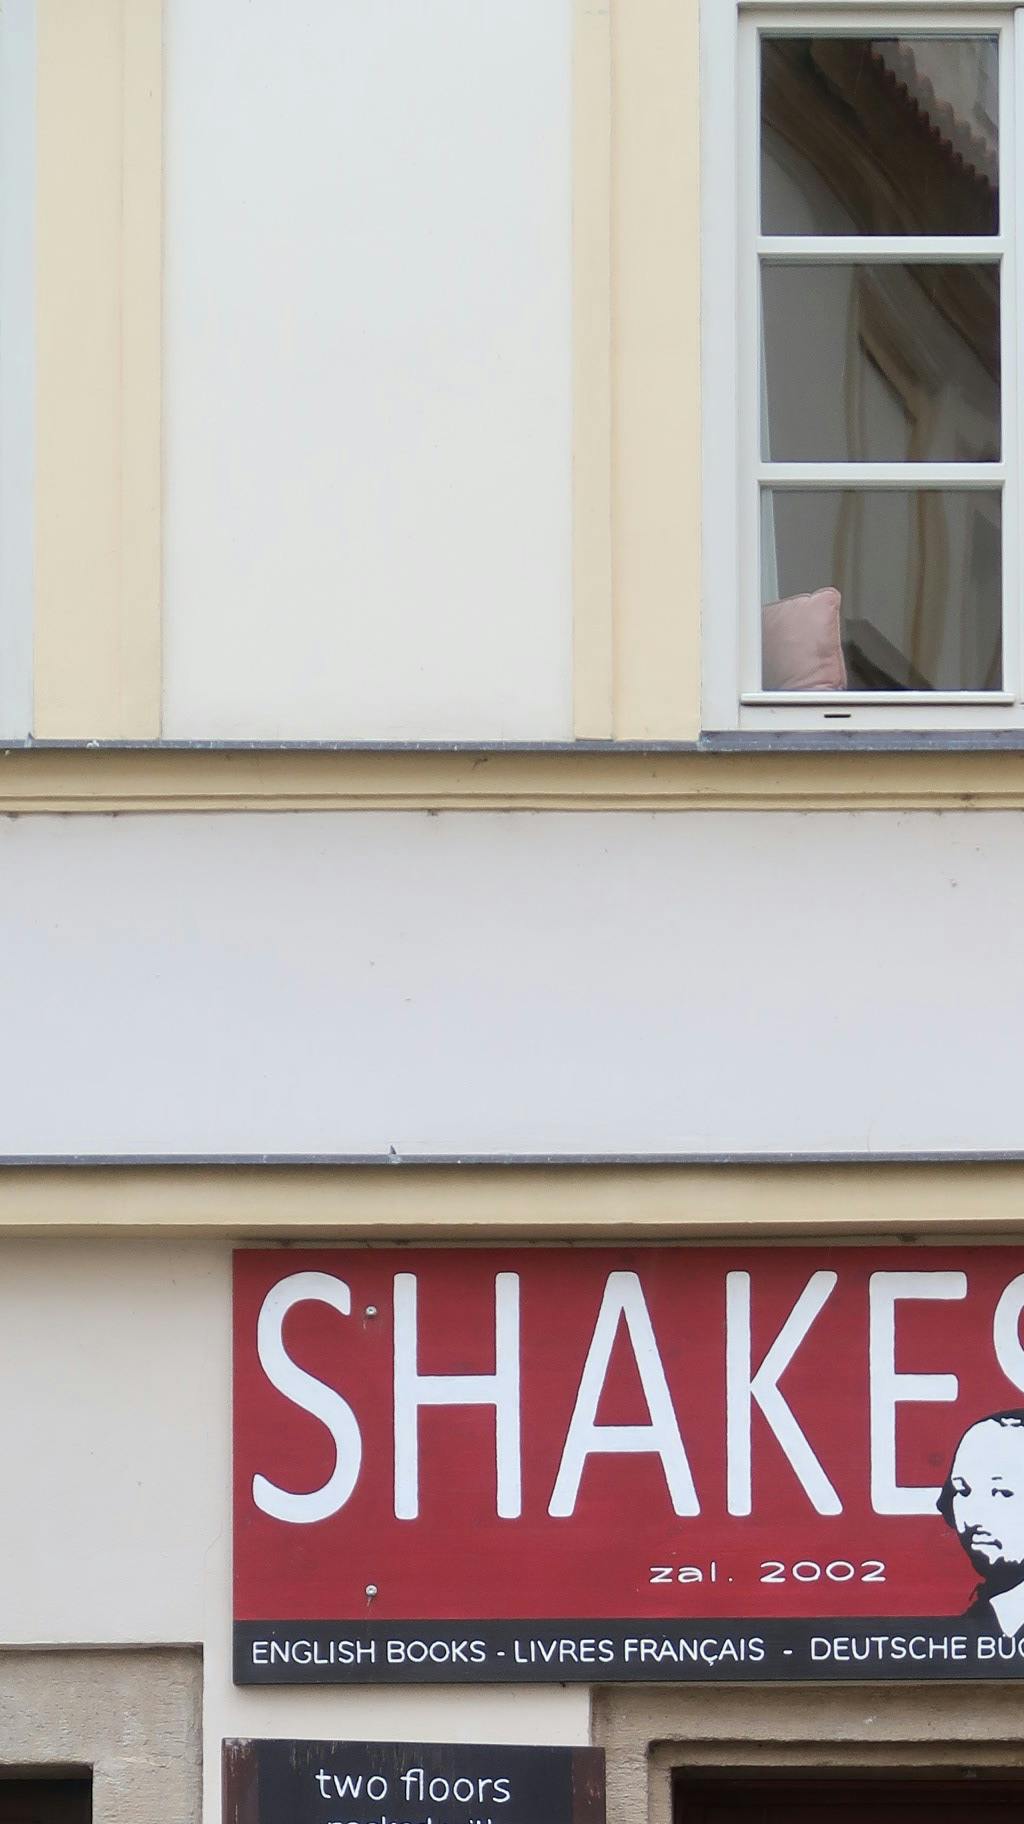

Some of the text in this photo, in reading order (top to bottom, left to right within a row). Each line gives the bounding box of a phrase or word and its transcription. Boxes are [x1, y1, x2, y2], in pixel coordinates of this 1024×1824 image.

[650, 1560, 887, 1583] zal. 2002
[252, 1640, 376, 1665] ENGLISH
[387, 1640, 486, 1664] BOOKS
[514, 1639, 615, 1663] LIVRES
[624, 1638, 765, 1667] FRANÇAIS
[810, 1636, 968, 1661] DEUTSCHE
[315, 1768, 511, 1803] two floors
